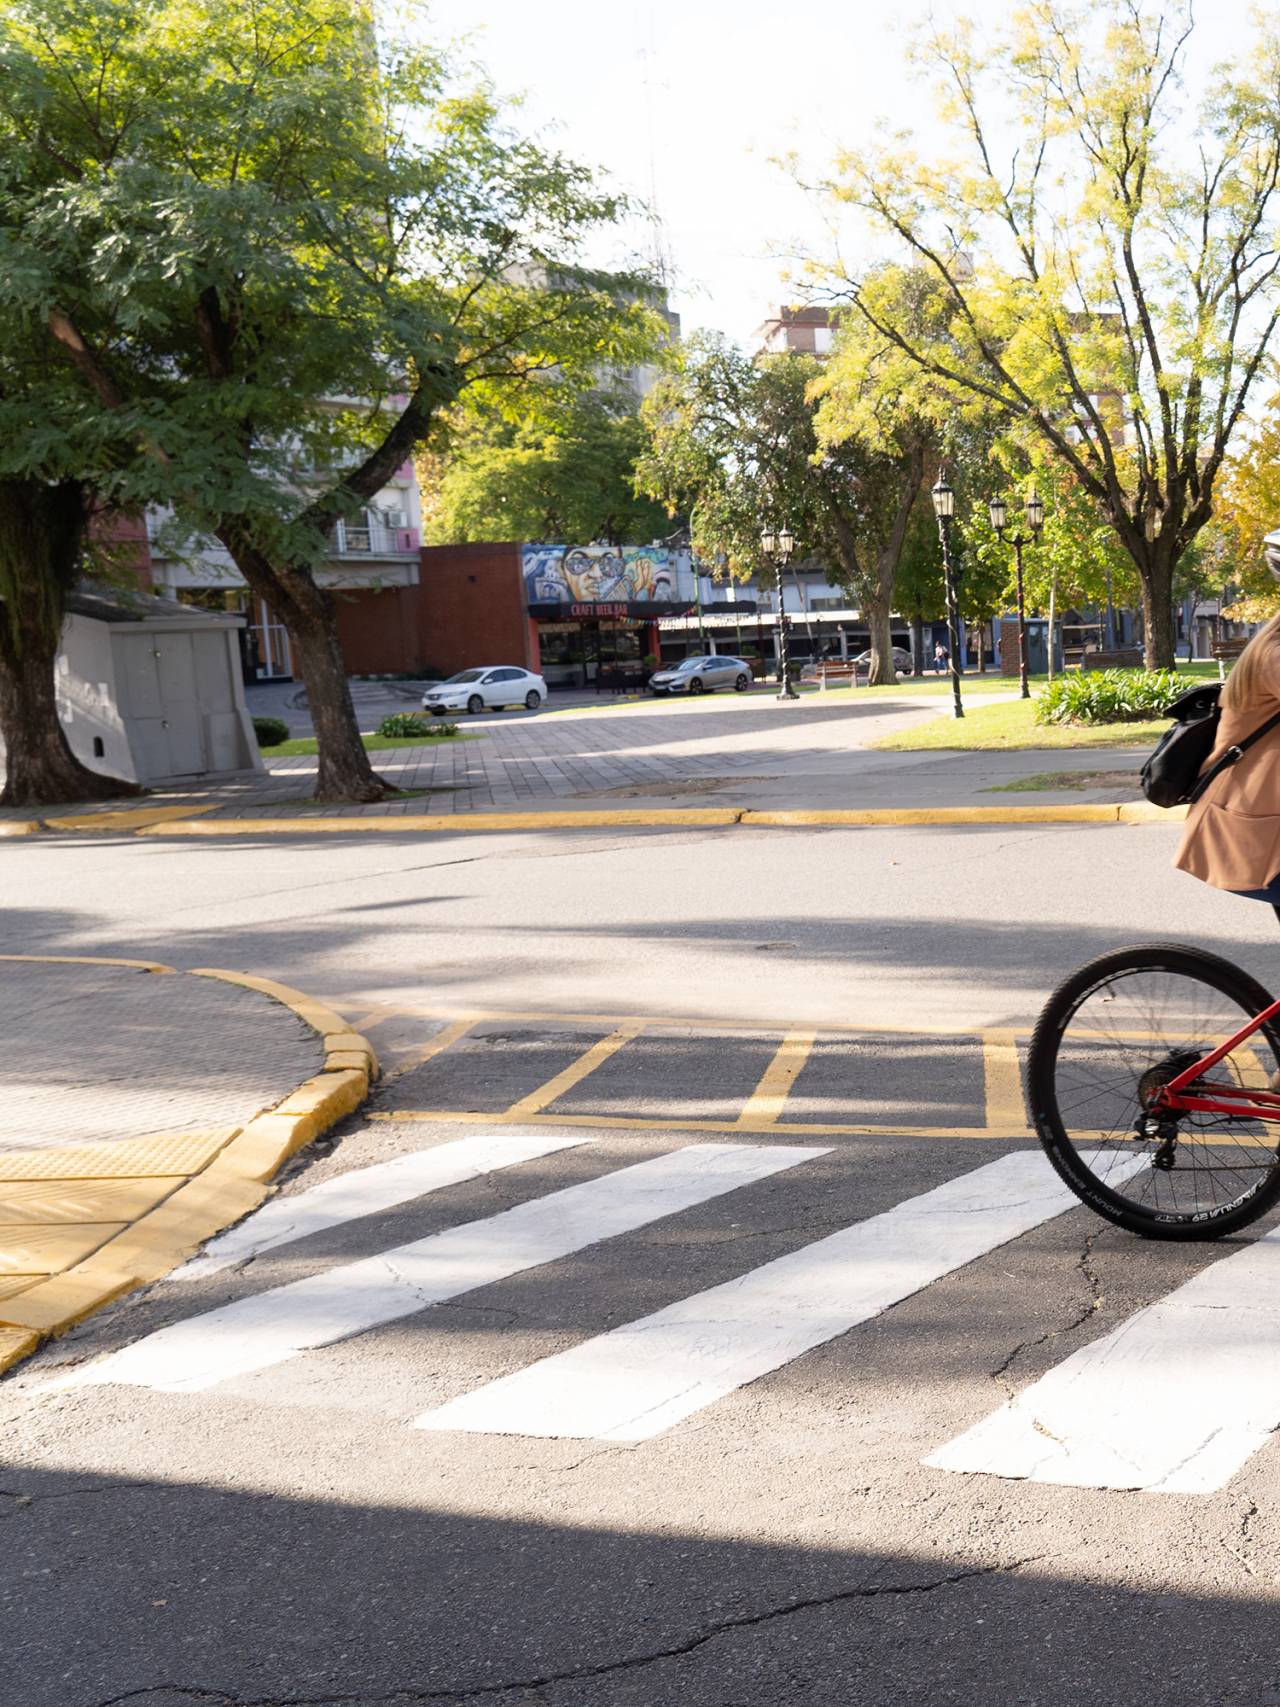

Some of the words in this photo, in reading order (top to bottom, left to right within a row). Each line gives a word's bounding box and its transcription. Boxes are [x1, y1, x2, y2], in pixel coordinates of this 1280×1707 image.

[571, 604, 593, 616] CRAFT
[596, 604, 613, 616] BEER
[614, 603, 628, 616] BAR
[1052, 1144, 1087, 1192] EMMONS
[1086, 1190, 1124, 1218] MOUNT
[1191, 1211, 1210, 1223] 29
